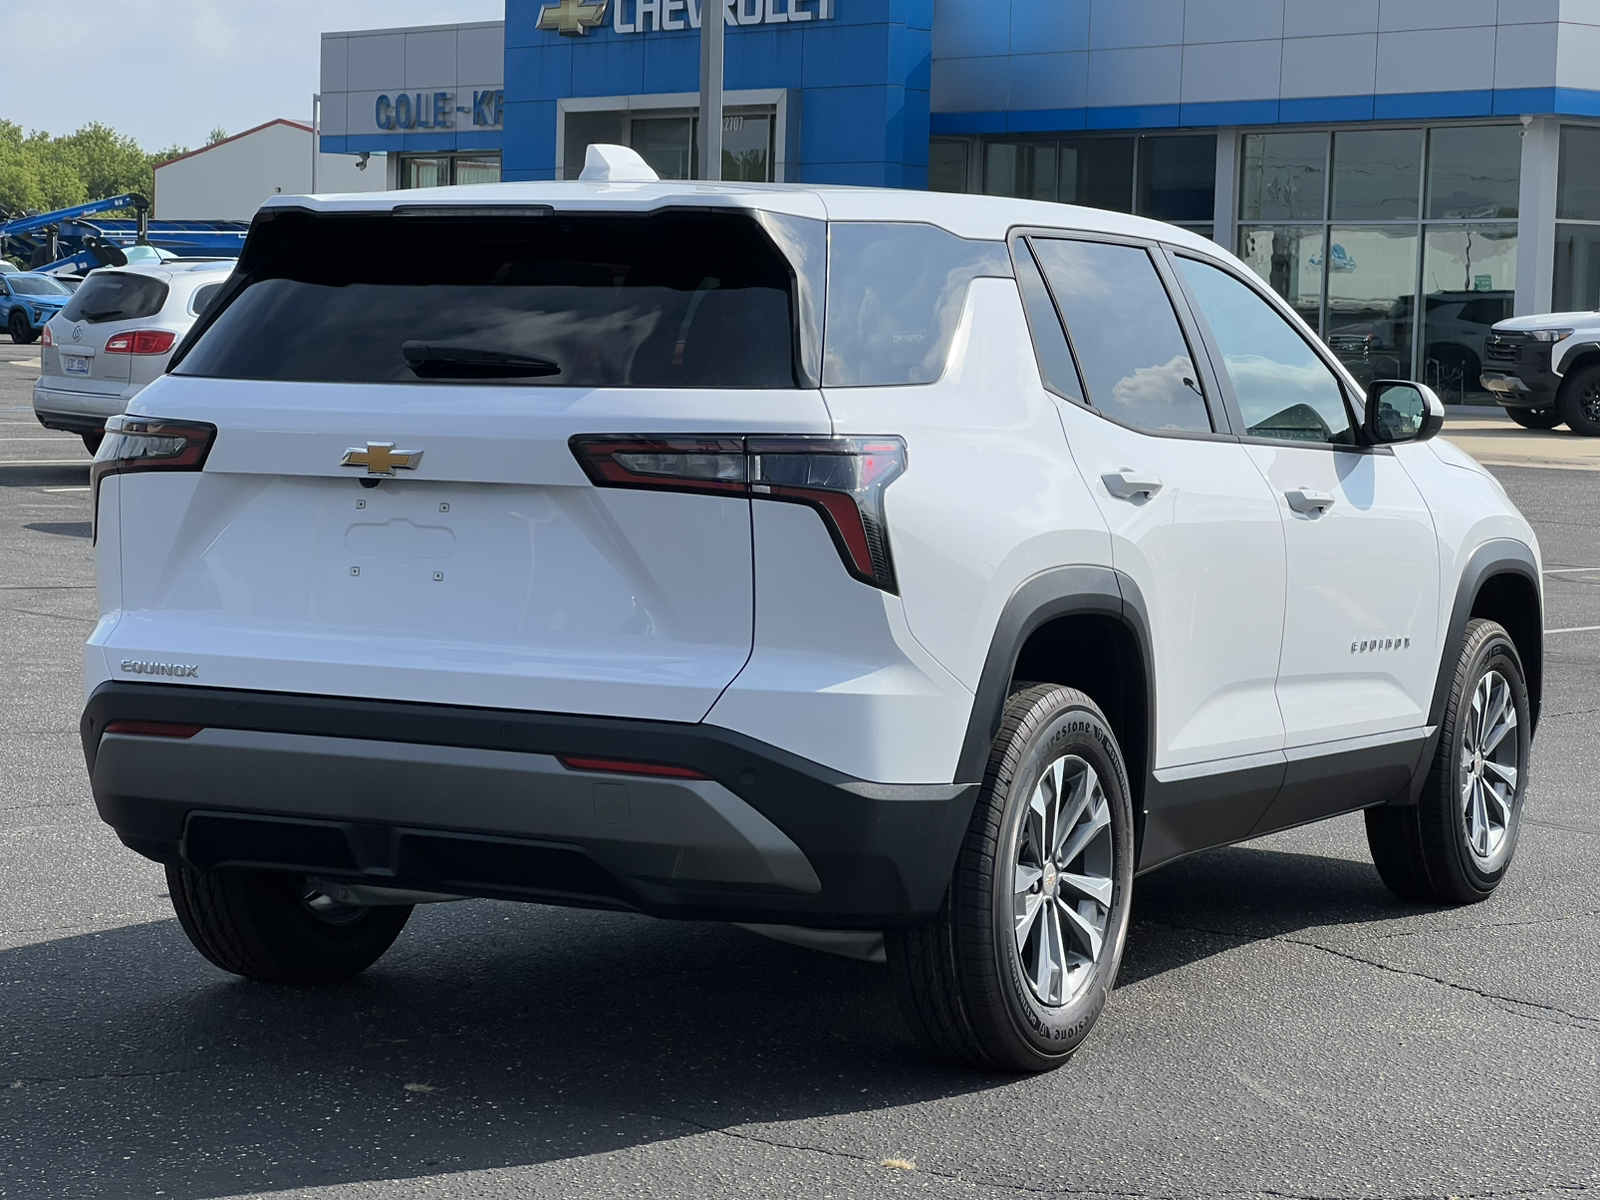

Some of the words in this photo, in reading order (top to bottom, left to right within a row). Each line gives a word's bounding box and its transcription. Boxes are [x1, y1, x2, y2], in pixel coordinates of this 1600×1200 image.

[1350, 637, 1411, 654] EQUINOX
[120, 659, 199, 678] EQUINOX
[1054, 997, 1103, 1041] irestone
